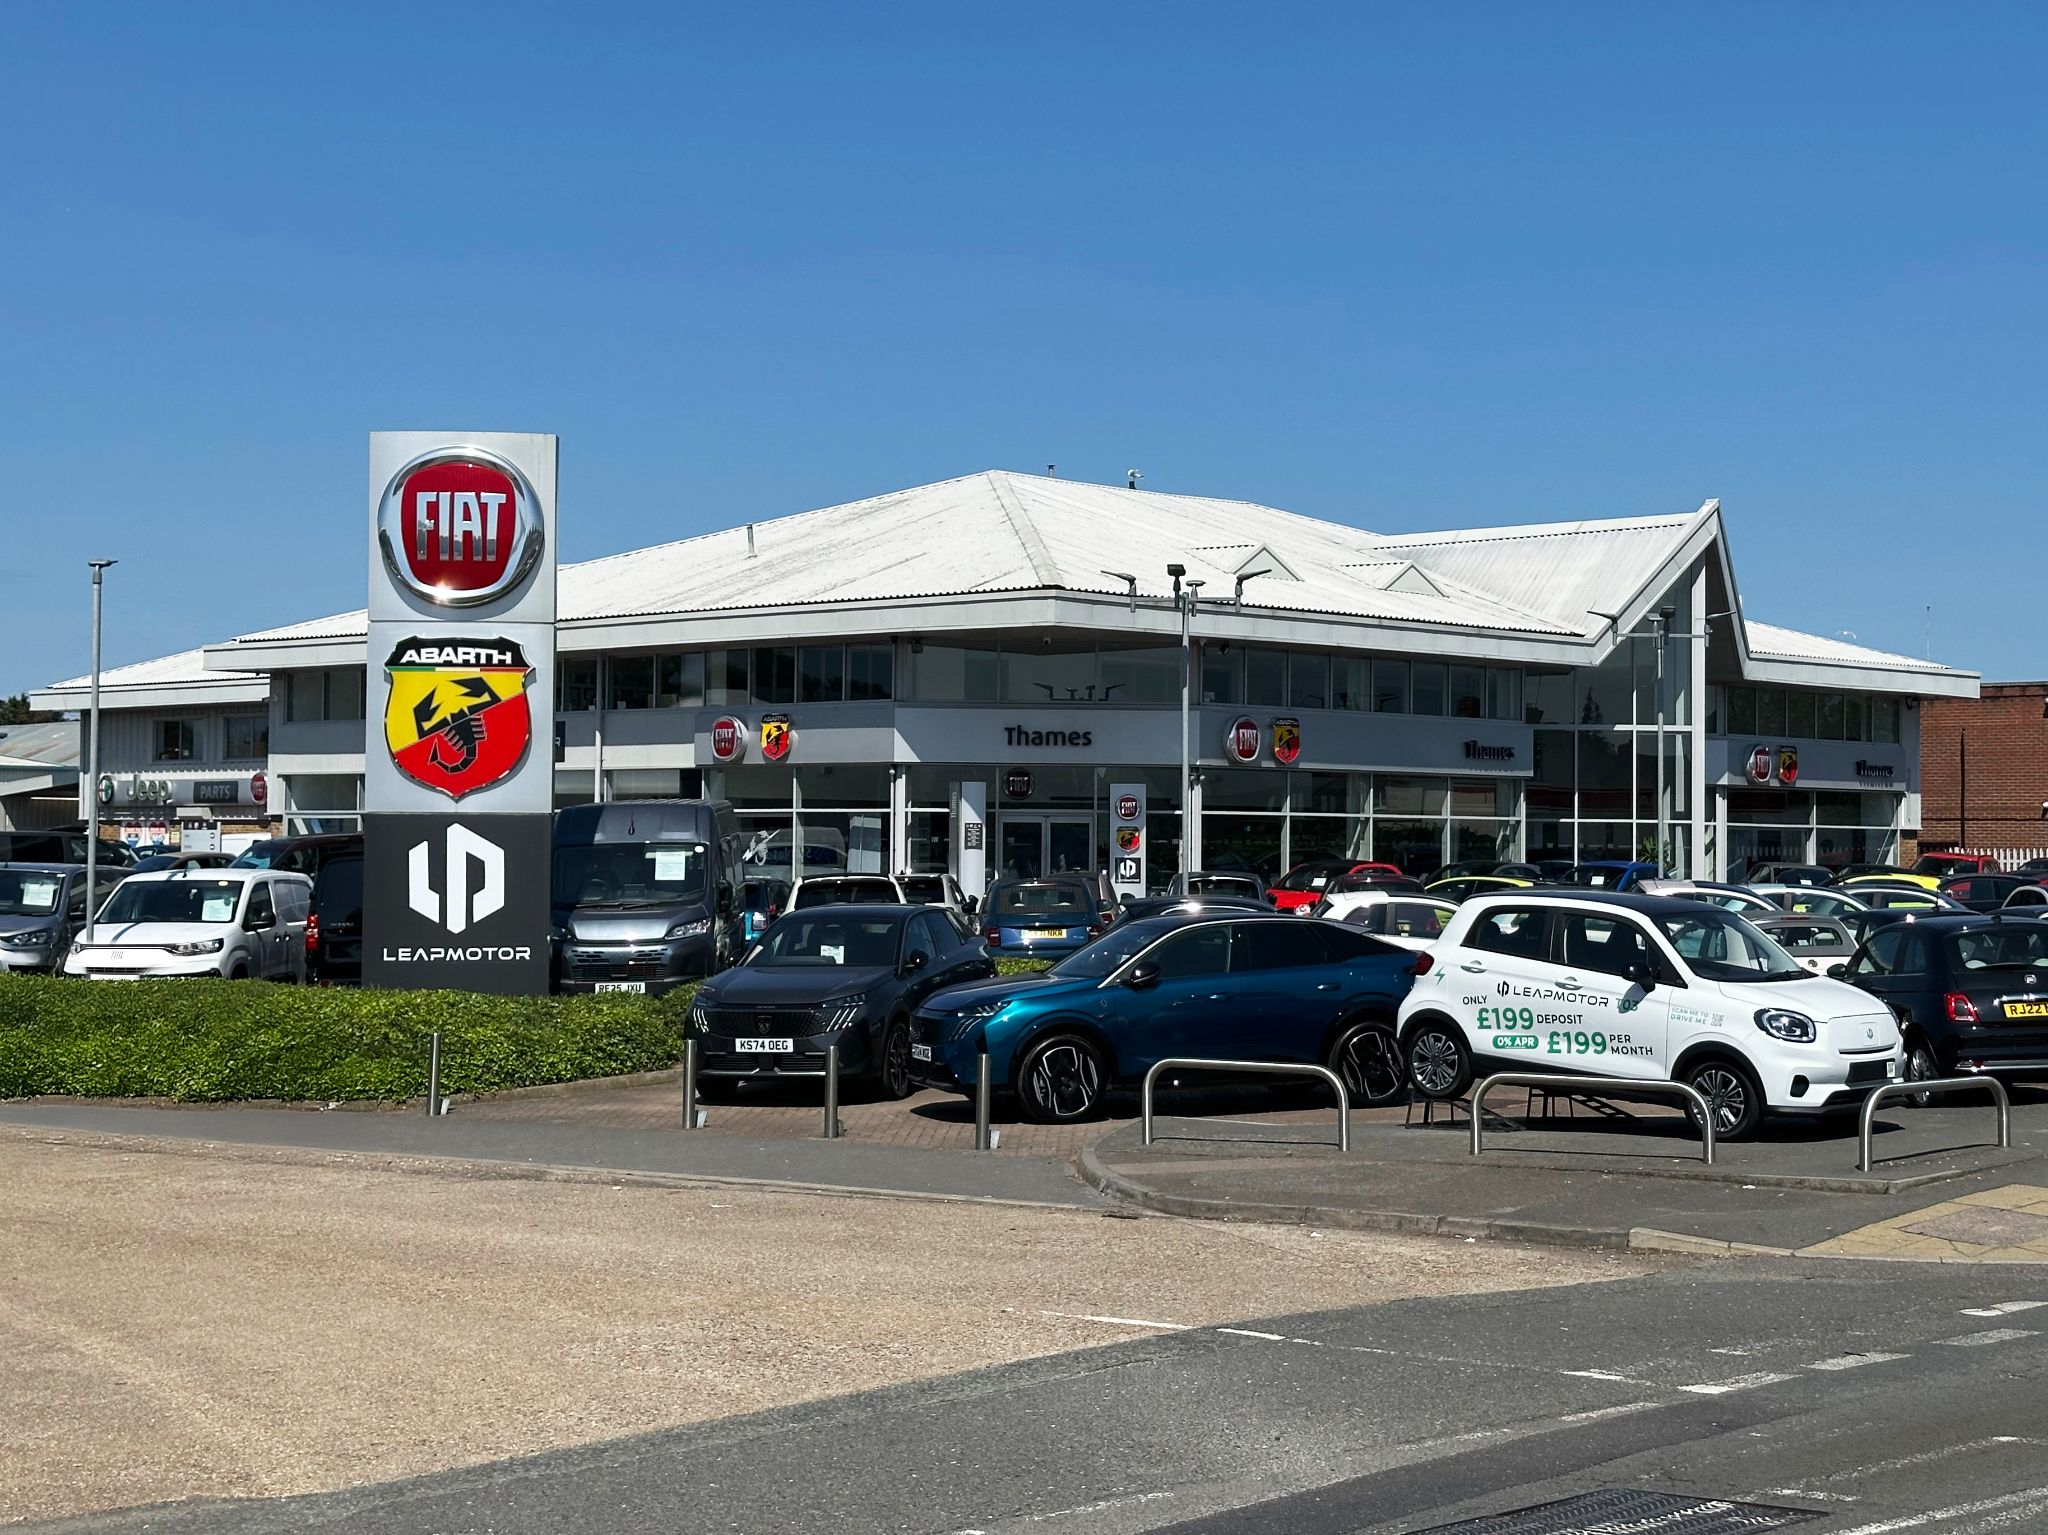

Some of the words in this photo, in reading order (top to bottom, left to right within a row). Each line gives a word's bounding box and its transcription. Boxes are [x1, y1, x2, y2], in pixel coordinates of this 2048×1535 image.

[416, 491, 507, 562] FIAT
[400, 647, 512, 665] ABARTH
[715, 728, 734, 749] FIAT
[1004, 725, 1092, 747] Thames
[1239, 729, 1257, 750] FIAT
[1463, 739, 1515, 760] Thames
[126, 774, 172, 805] Jeep
[200, 785, 231, 799] PARTS
[383, 947, 531, 961] LEAPMOTOR
[1462, 995, 1488, 1006] ONLY
[1513, 985, 1609, 1008] LEAPMOTOR
[1477, 1007, 1534, 1031] £199
[1537, 1014, 1583, 1025] DEPOSIT
[1671, 1013, 1693, 1023] DRIVE
[2009, 1004, 2043, 1016] RJ22
[740, 1040, 766, 1050] KS74
[1497, 1037, 1512, 1047] 0%
[1514, 1037, 1535, 1048] APR
[1547, 1031, 1607, 1055] £199
[1609, 1034, 1632, 1044] PER
[1611, 1045, 1653, 1056] MONTH
